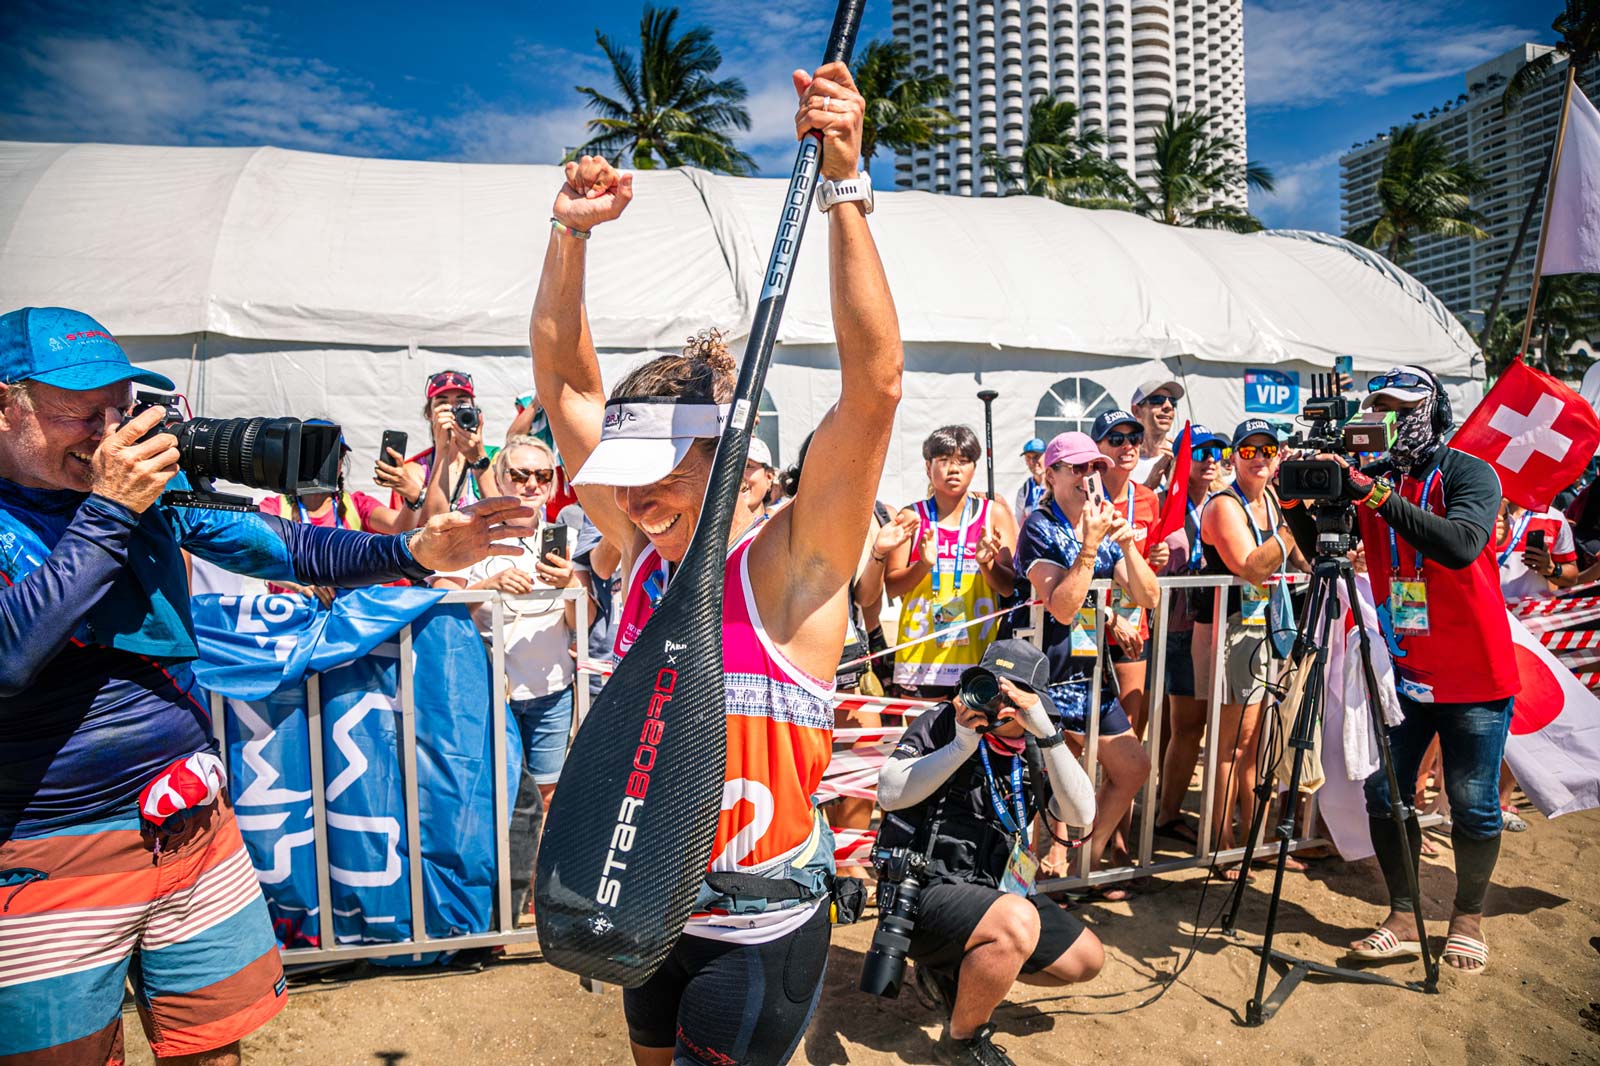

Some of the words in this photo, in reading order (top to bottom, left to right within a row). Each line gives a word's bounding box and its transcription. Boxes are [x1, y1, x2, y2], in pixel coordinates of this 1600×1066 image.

[1256, 384, 1290, 405] VIP
[596, 667, 678, 908] STARBOARD
[711, 778, 774, 872] 2
